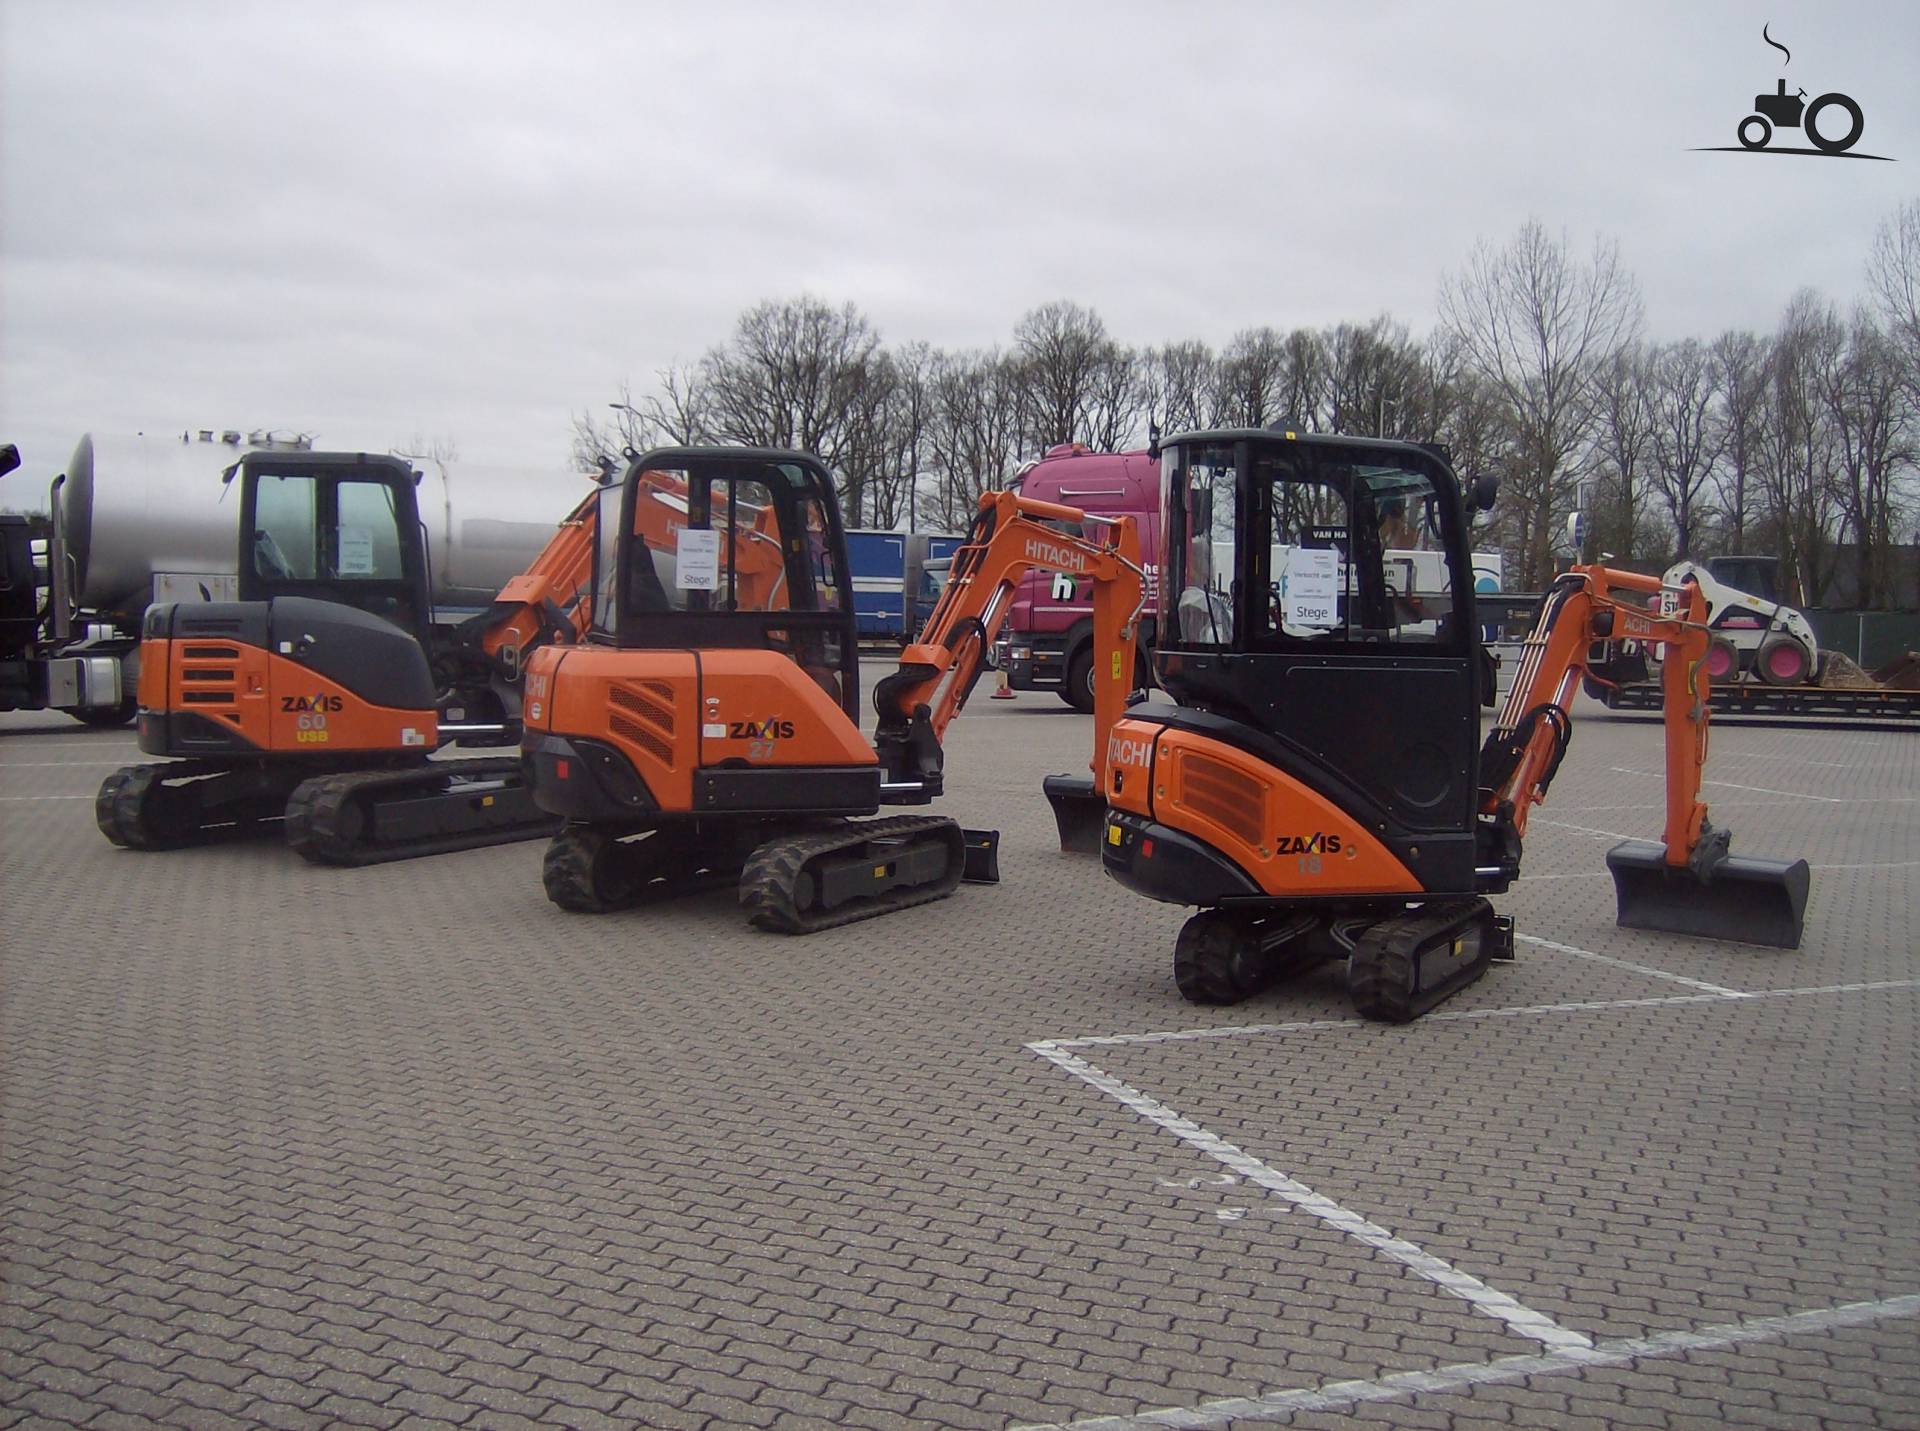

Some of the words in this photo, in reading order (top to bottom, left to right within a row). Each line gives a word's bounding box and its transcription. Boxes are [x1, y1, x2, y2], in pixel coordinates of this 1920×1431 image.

[1312, 530, 1332, 539] VAN
[1024, 537, 1085, 571] HITACHI
[684, 574, 711, 586] Stege
[1296, 606, 1329, 620] Stege
[281, 692, 343, 712] ZAXIS
[298, 713, 326, 730] 60
[730, 715, 794, 739] ZAXIS
[296, 730, 328, 742] USB
[1276, 831, 1342, 855] ZAXIS
